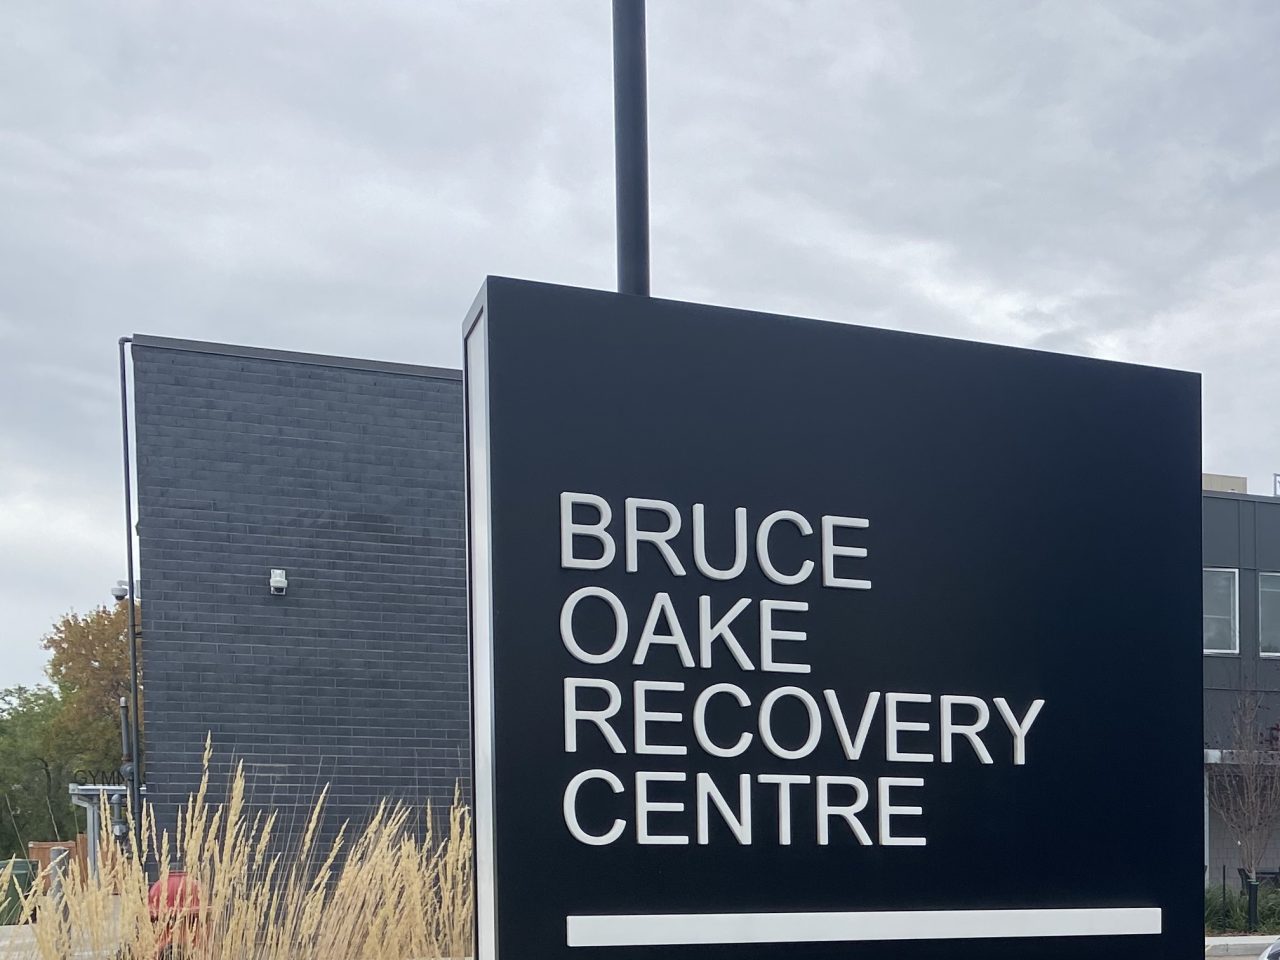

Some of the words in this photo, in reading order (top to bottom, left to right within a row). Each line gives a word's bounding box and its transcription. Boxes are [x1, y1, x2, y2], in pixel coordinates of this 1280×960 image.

[559, 491, 873, 591] BRUCE
[559, 586, 813, 675] OAKE
[562, 677, 1047, 766] RECOVERY
[562, 768, 928, 847] CENTRE
